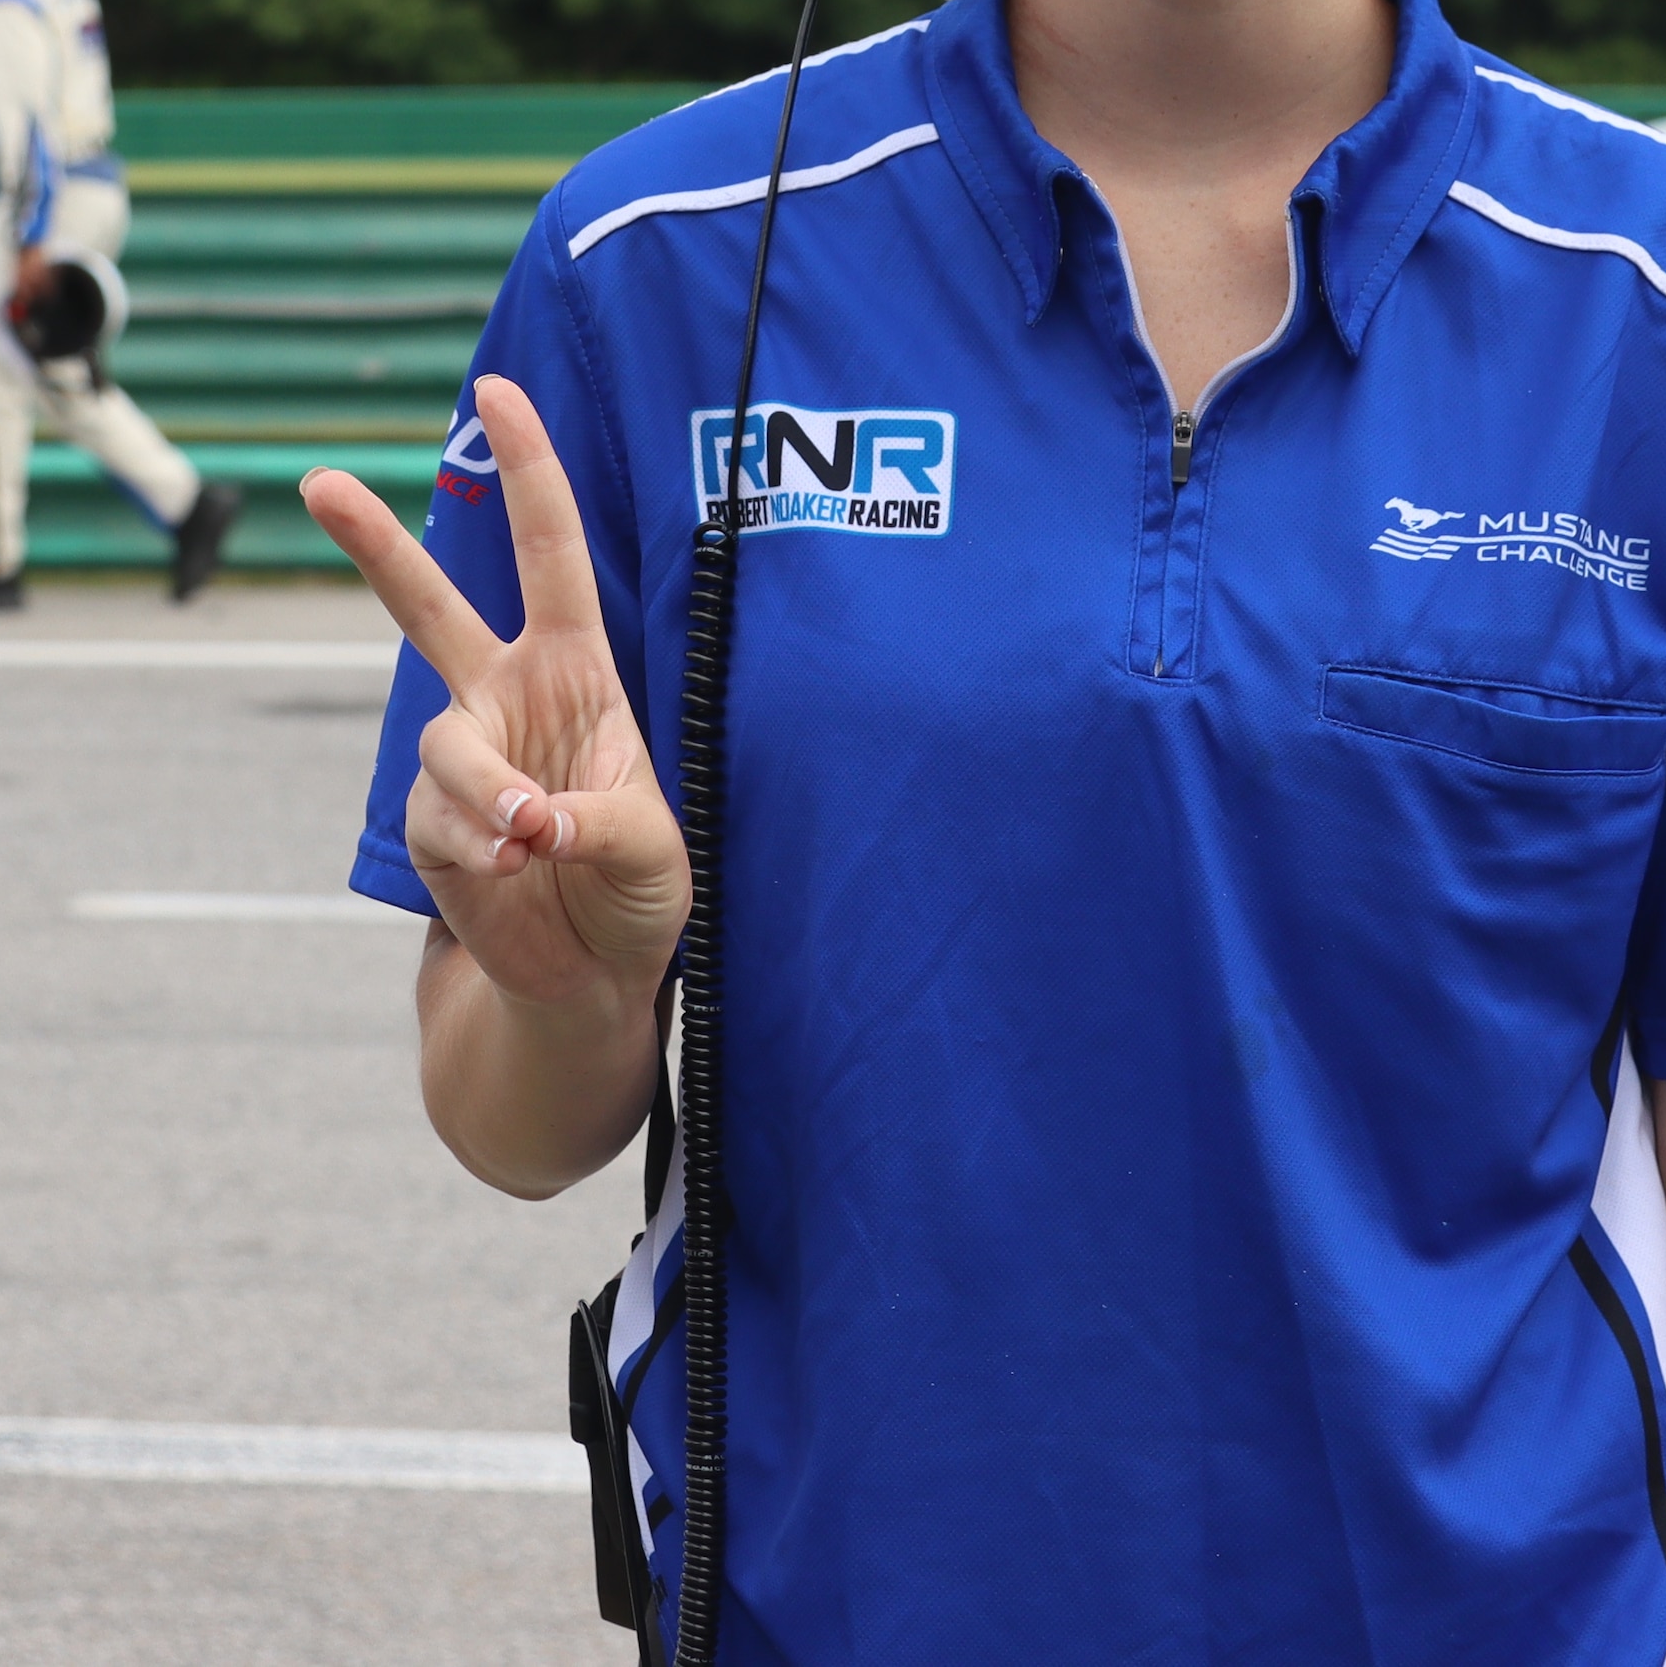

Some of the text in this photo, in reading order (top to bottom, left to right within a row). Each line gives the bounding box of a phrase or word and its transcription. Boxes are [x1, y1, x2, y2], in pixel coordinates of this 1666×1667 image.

[700, 411, 941, 494] RNR
[848, 499, 941, 529] RACING
[1479, 511, 1650, 561] MUSTANG
[1476, 544, 1649, 591] CHALLENGE
